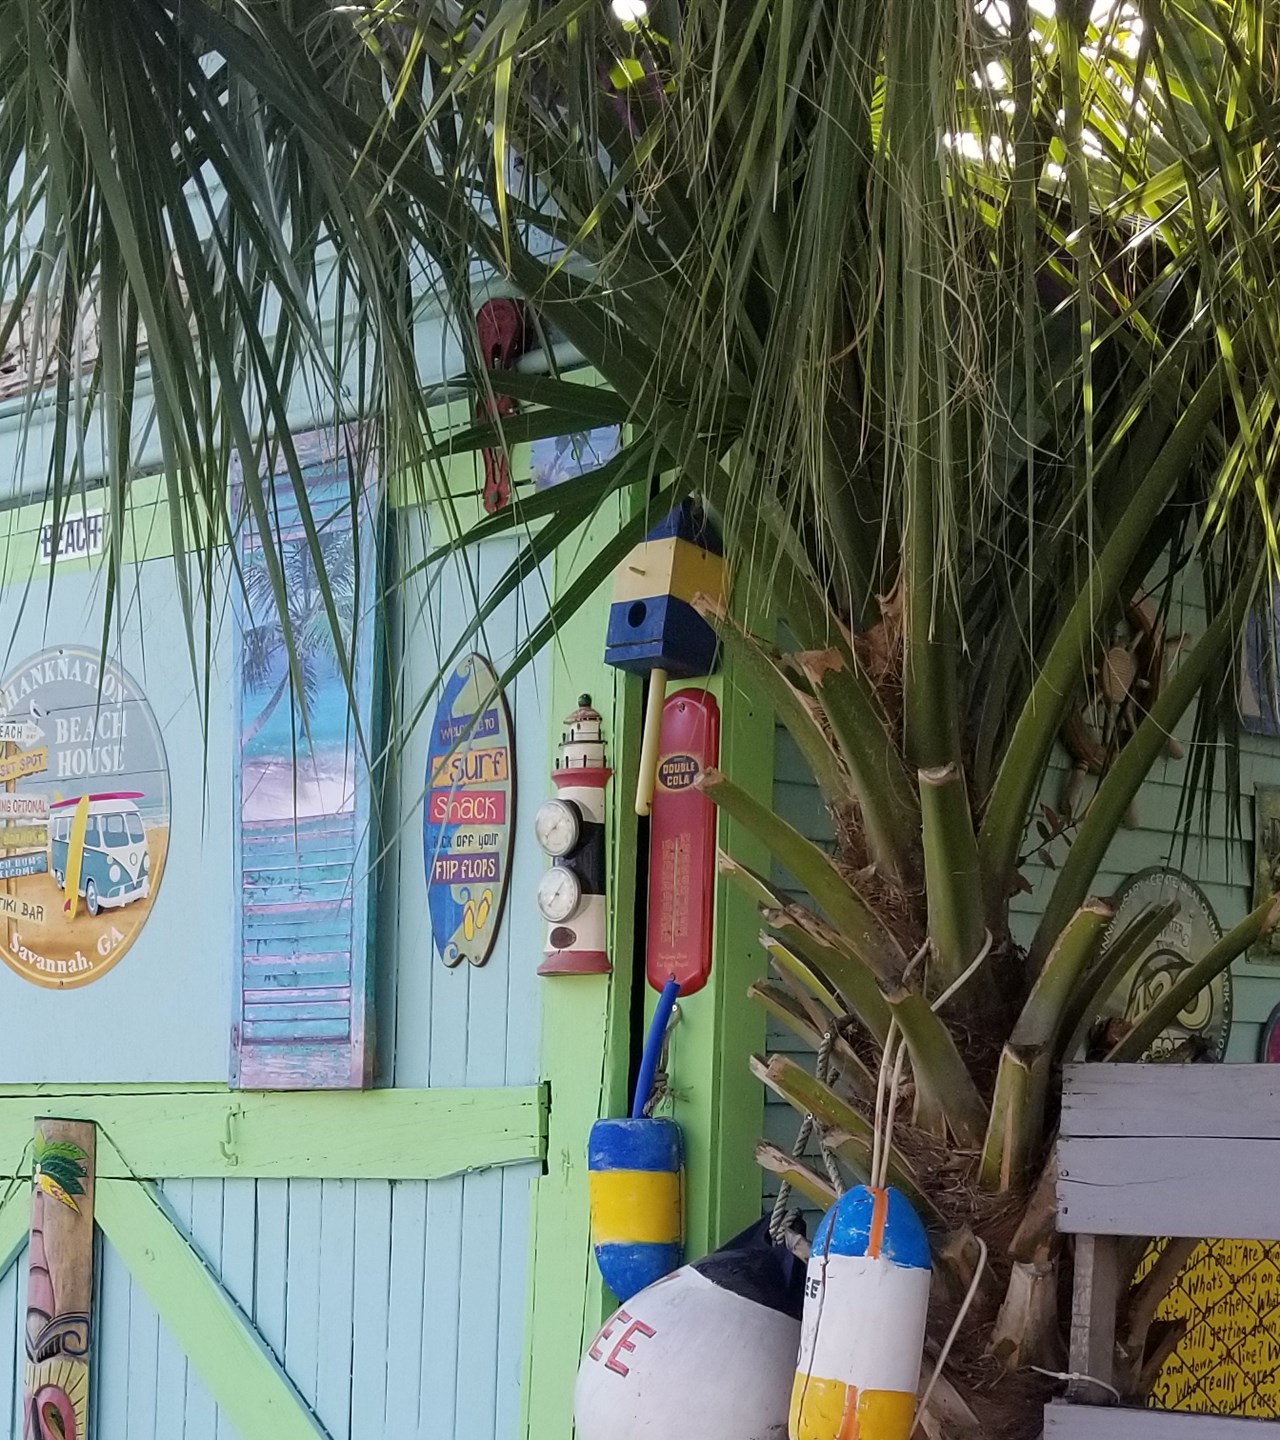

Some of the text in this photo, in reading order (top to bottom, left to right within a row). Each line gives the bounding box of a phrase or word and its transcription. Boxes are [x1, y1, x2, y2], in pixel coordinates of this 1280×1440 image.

[54, 710, 128, 745] BEACH
[19, 753, 44, 772] SPOT
[56, 744, 125, 778] HOUSE
[662, 761, 696, 775] DOUBLE
[667, 774, 691, 787] COLA
[21, 901, 45, 922] BAR
[9, 925, 125, 974] Savannah, GA
[1261, 1271, 1274, 1284] on
[1166, 1361, 1184, 1377] and
